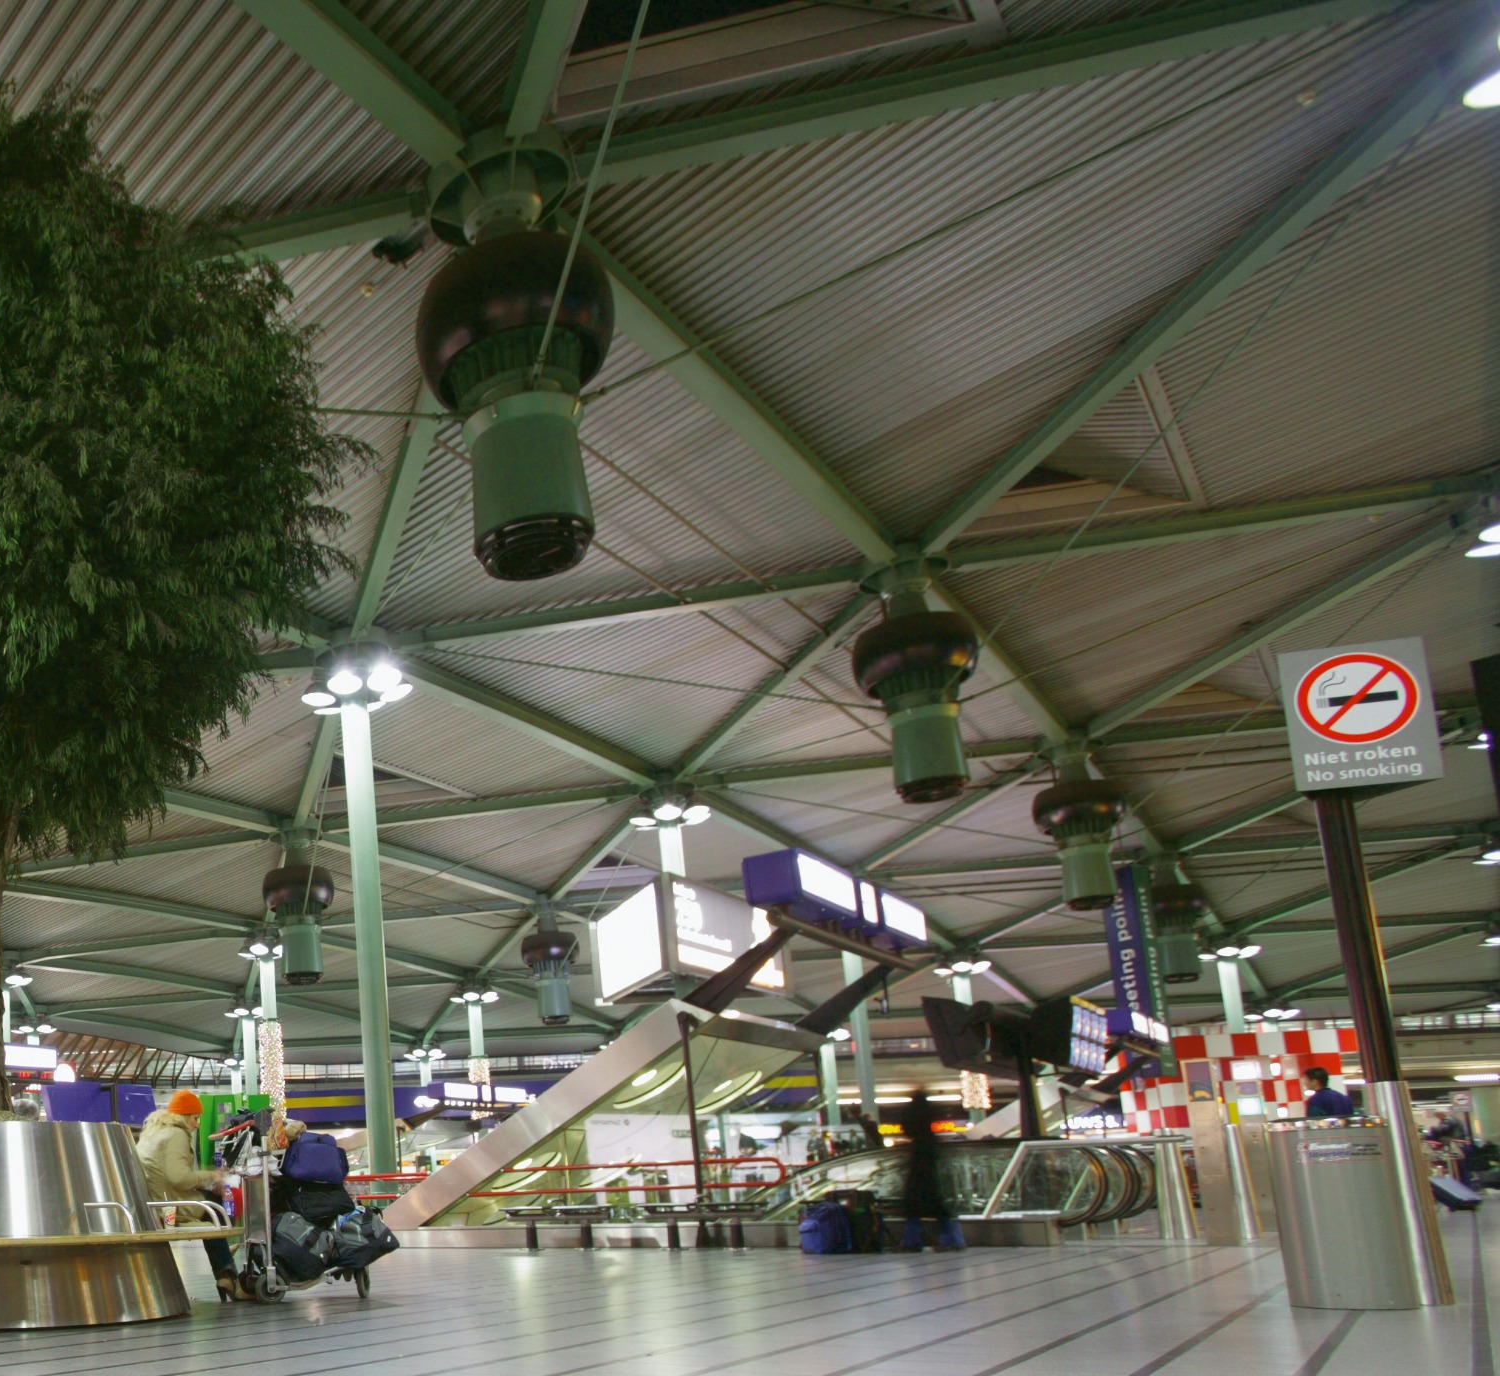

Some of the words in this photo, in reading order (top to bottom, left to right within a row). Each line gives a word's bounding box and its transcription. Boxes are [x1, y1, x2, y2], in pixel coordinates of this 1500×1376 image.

[1304, 750, 1349, 766] Niet
[1355, 745, 1417, 761] roken
[1307, 769, 1334, 783] No
[1339, 762, 1423, 780] smoking
[1111, 888, 1133, 942] poin
[1120, 948, 1140, 1011] eeting
